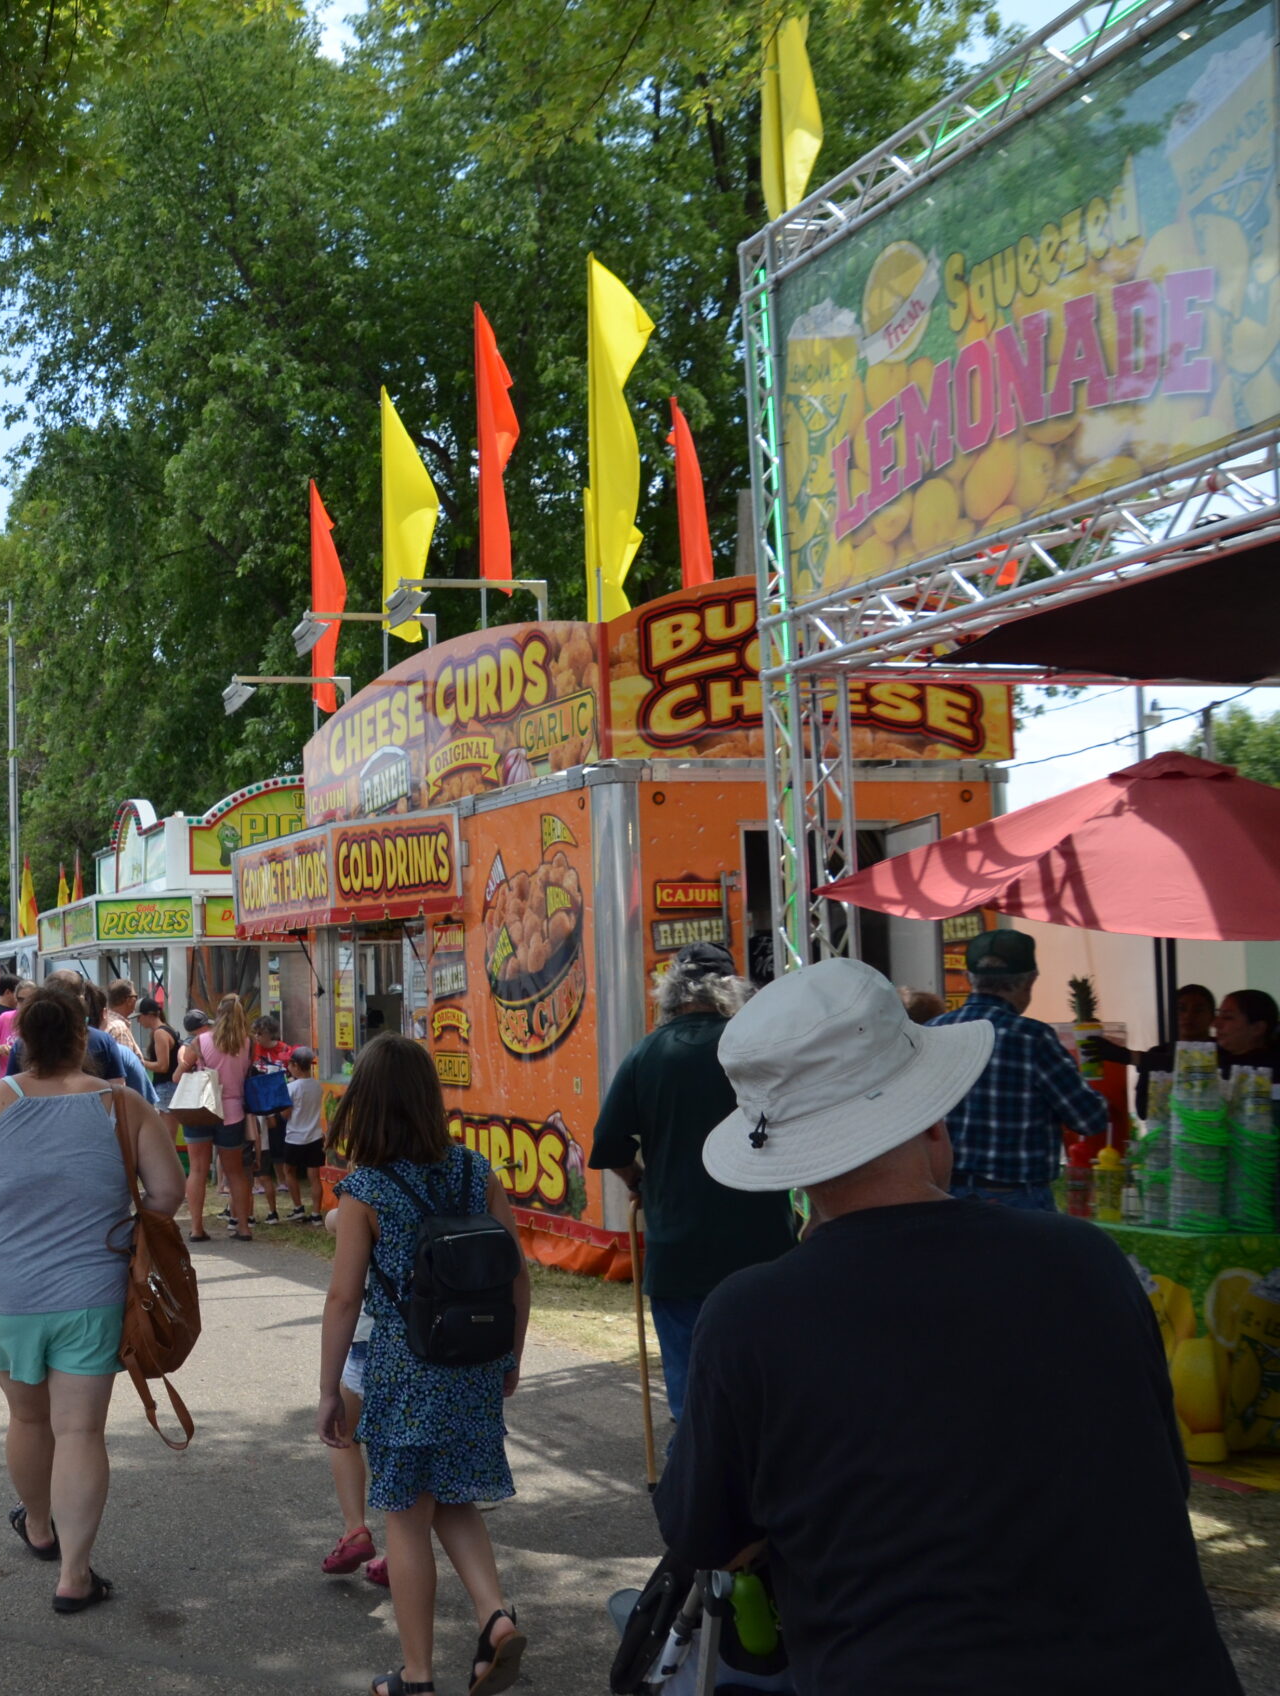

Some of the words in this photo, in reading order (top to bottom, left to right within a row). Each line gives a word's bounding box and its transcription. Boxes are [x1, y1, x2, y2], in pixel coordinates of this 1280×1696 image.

[944, 153, 1142, 337] Squeezed
[883, 299, 926, 349] Fresh
[831, 267, 1214, 542] LEMONADE
[330, 680, 424, 776] CHEESE
[435, 640, 549, 727] CURDS
[524, 701, 589, 753] GARLIC
[434, 738, 489, 774] ORIGINAL
[312, 786, 345, 815] CAJUN
[363, 759, 408, 814] RANCH
[338, 840, 383, 893] COLD
[384, 831, 451, 892] DRINKS
[485, 853, 505, 902] CAJUN
[242, 860, 282, 911] GOURMET
[284, 851, 328, 904] FLAVORS
[662, 888, 718, 903] CAJUN
[103, 909, 191, 935] PICKLES
[136, 903, 157, 913] Cold
[435, 927, 463, 949] CAJUN
[660, 919, 723, 947] RANCH
[943, 915, 980, 939] NCH
[435, 962, 465, 994] RANCH
[437, 1010, 464, 1026] ORIGINAL
[437, 1058, 467, 1079] GARLIC
